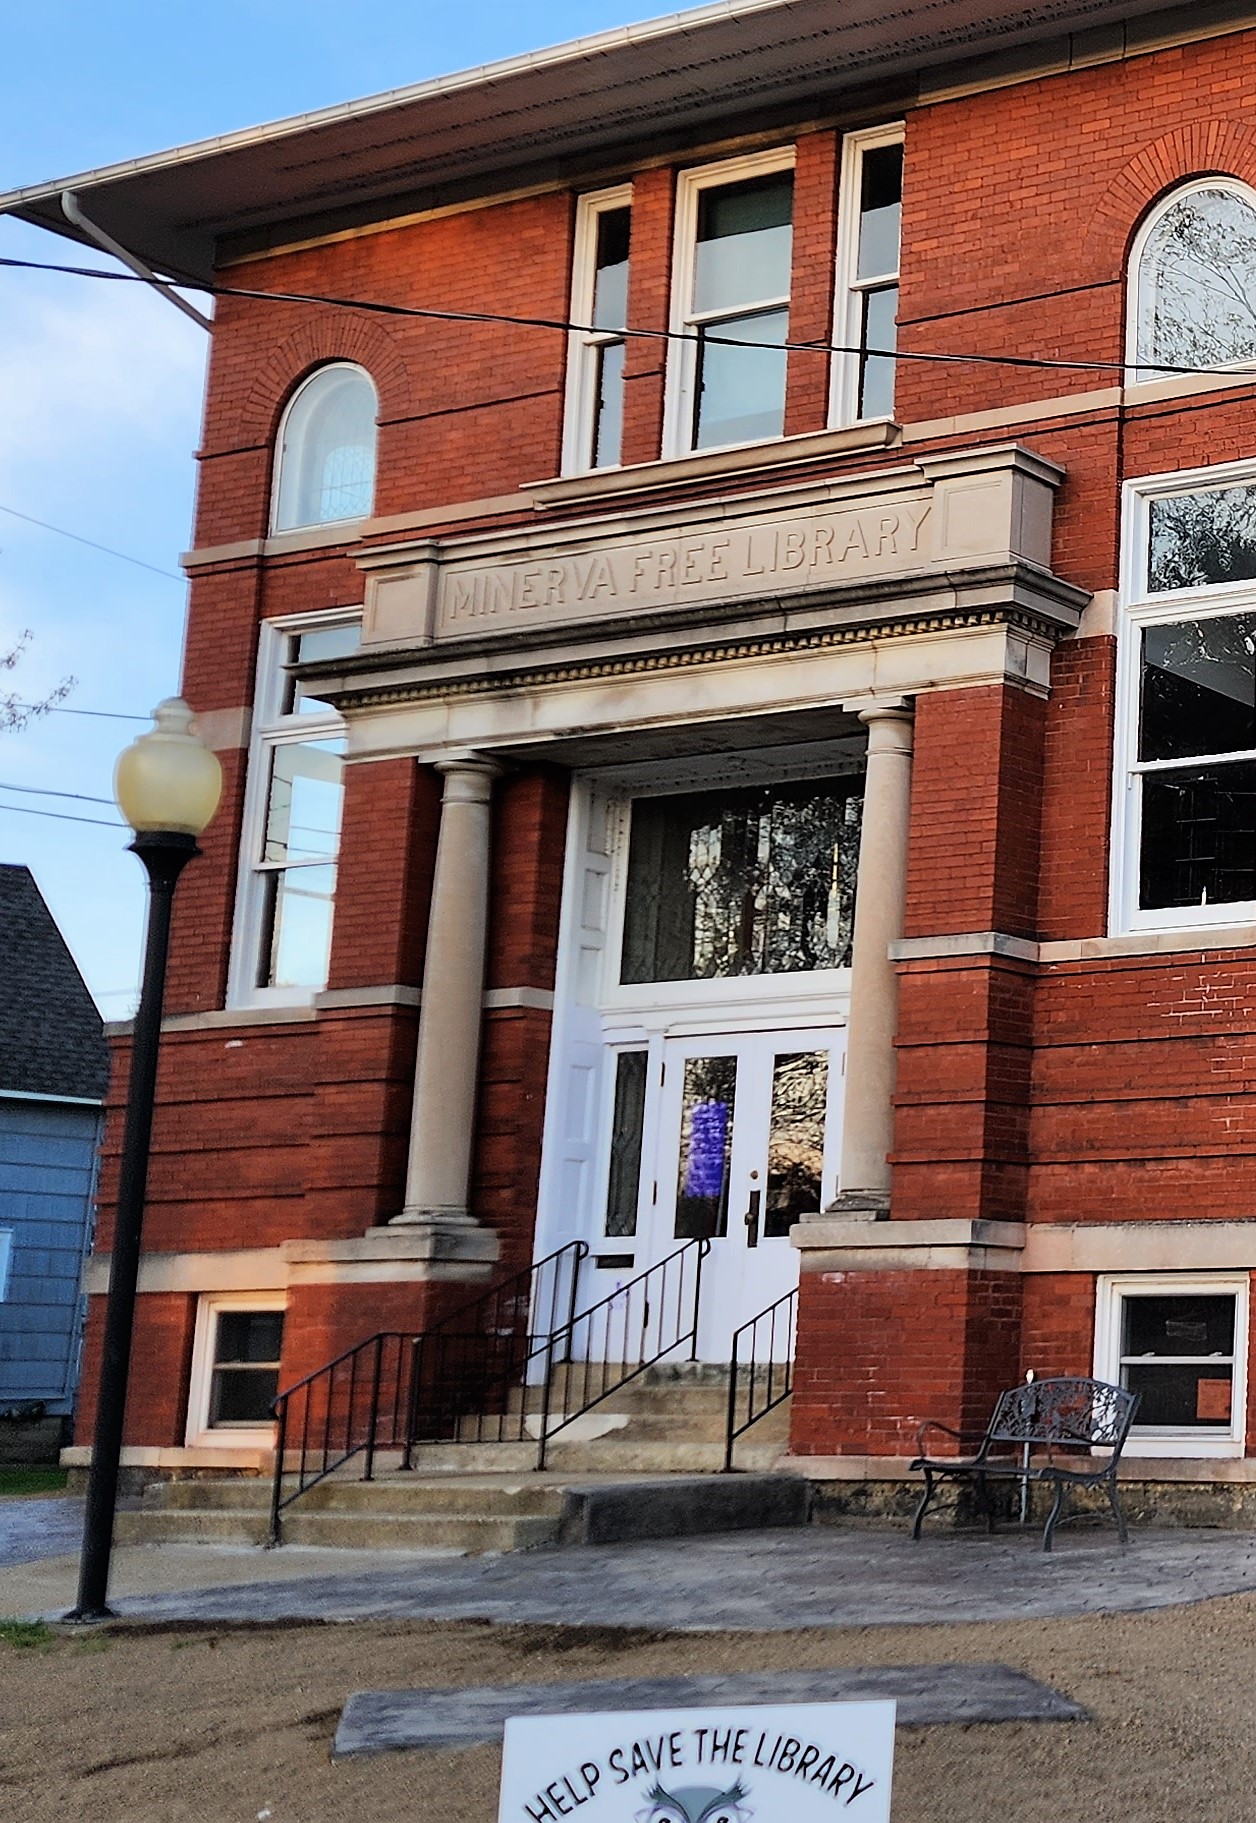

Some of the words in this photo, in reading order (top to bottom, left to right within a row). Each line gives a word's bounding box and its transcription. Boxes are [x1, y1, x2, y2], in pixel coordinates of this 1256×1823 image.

[449, 556, 618, 620] MINERVA
[629, 538, 731, 593] FREE
[743, 506, 932, 577] LIBRARY
[525, 1762, 600, 1823] HELP
[609, 1731, 683, 1784] SAVE
[695, 1728, 750, 1764] THE
[754, 1732, 875, 1806] LIBRARY
